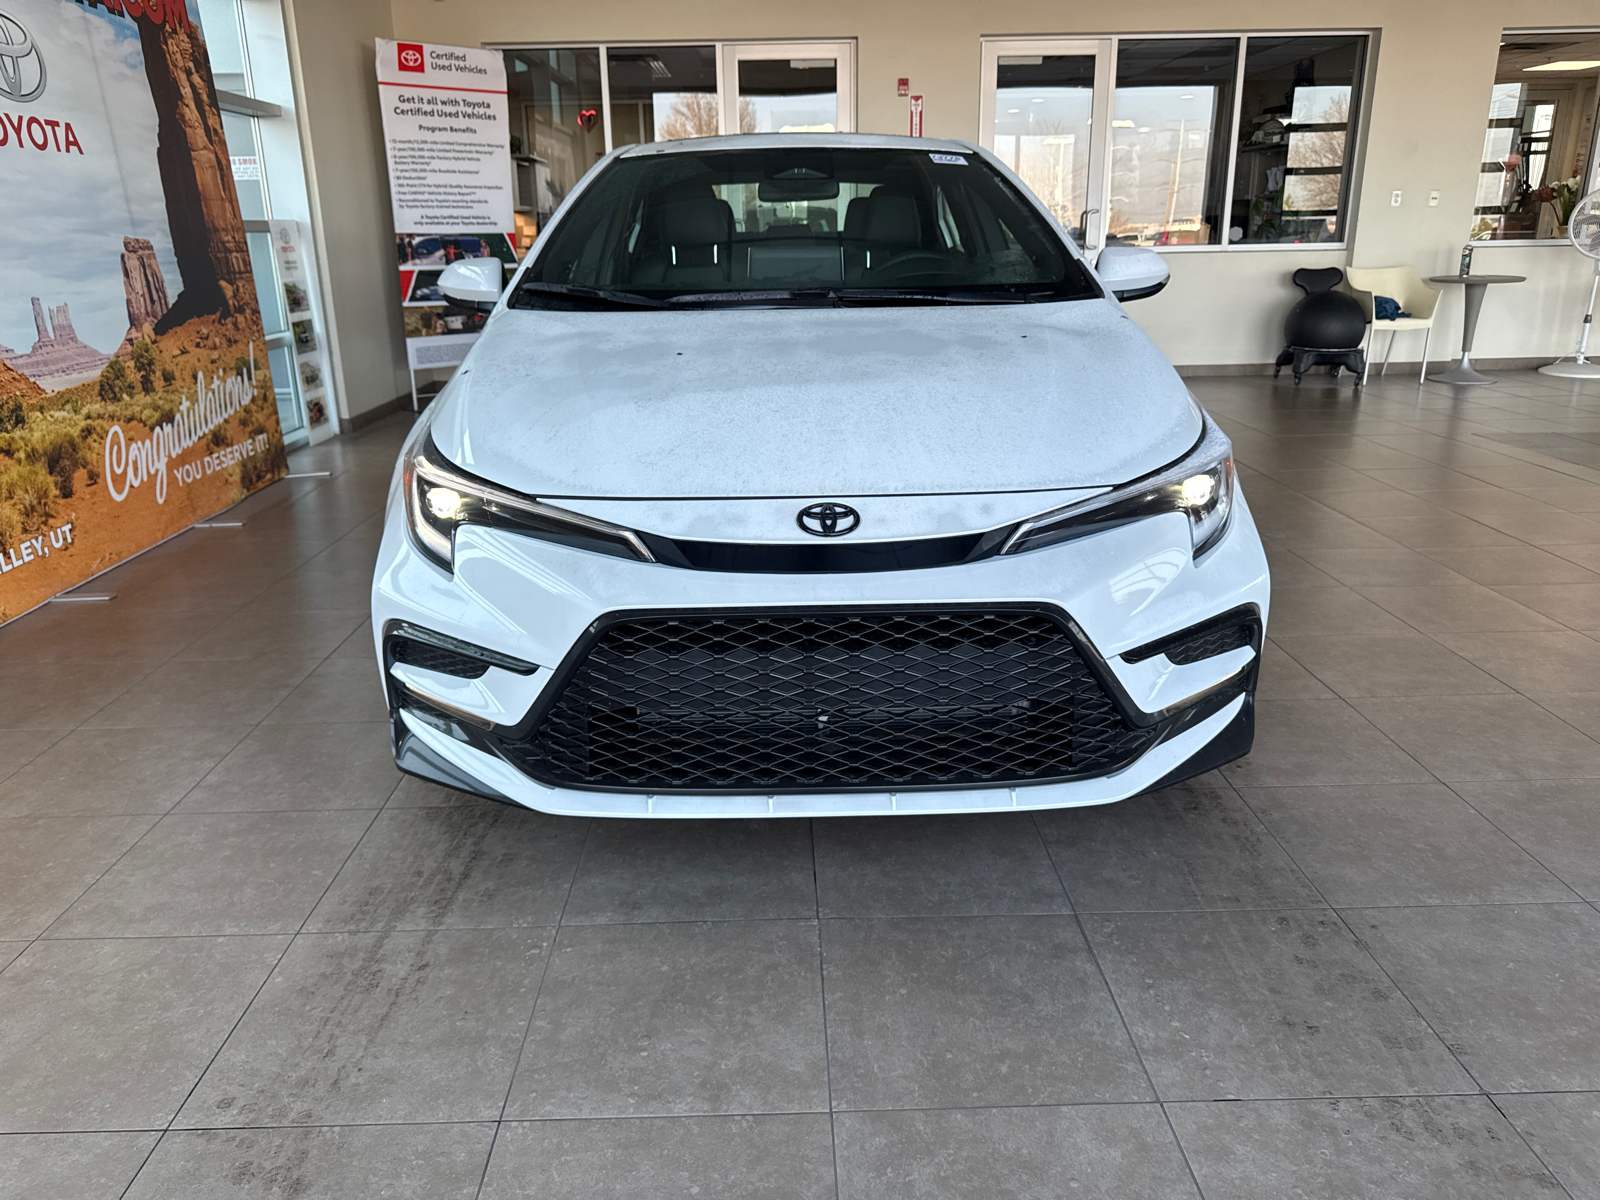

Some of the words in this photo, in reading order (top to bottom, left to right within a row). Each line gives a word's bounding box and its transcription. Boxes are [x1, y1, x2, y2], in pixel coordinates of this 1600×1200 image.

[429, 50, 467, 62] Certified
[430, 61, 452, 72] Used
[454, 63, 488, 75] Vehicles
[398, 94, 416, 104] Get
[417, 95, 424, 105] it
[426, 96, 439, 106] all
[440, 97, 460, 107] with
[461, 98, 491, 110] Toyota
[393, 106, 435, 117] Certified
[436, 109, 459, 119] Used
[460, 110, 497, 121] Vehicles
[418, 124, 448, 133] Program
[449, 126, 477, 134] Benefits
[105, 341, 258, 505] Congratulations!
[173, 459, 202, 486] YOU
[203, 438, 255, 475] DESERVE
[255, 432, 270, 453] IT!
[0, 535, 49, 575] LLEY,
[49, 522, 72, 549] UT
